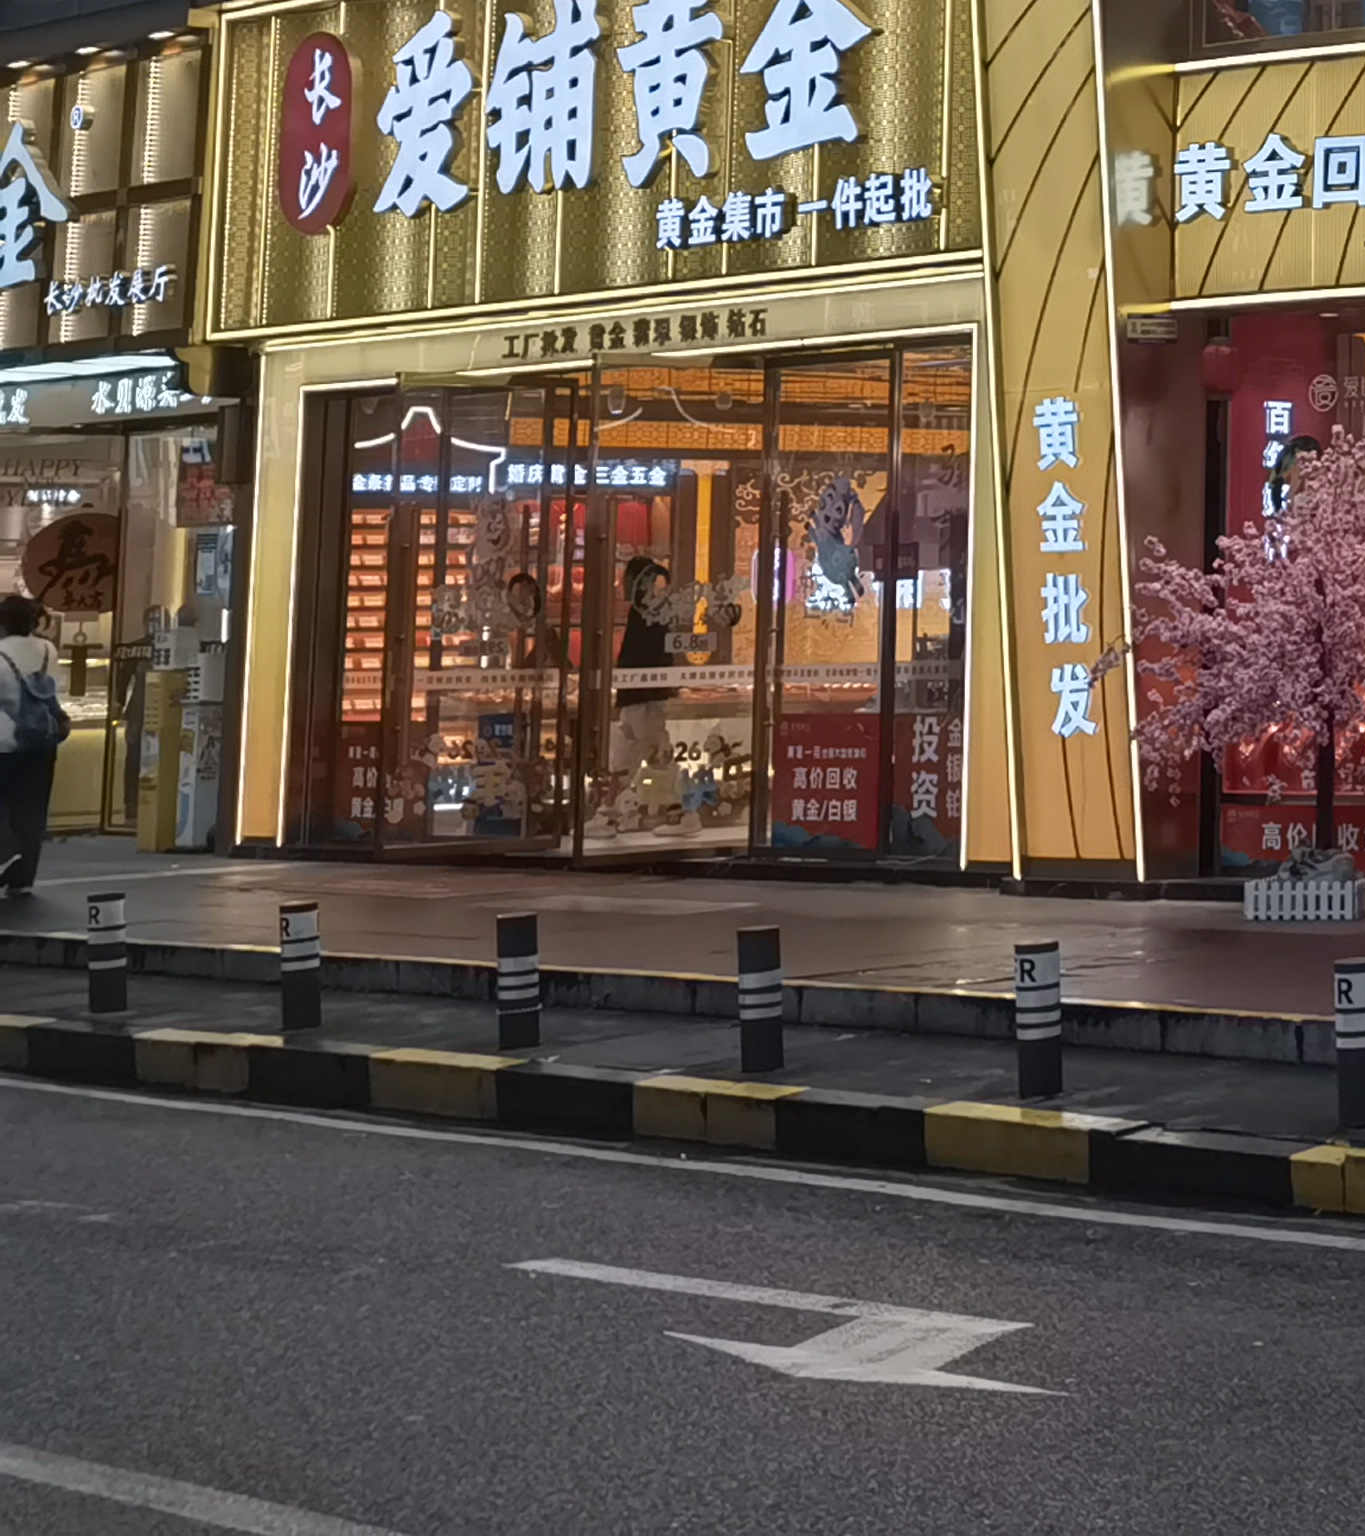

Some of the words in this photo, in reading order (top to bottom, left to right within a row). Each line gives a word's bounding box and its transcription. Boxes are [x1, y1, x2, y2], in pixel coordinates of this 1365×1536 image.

[298, 48, 342, 220] 长沙
[654, 192, 786, 248] 黄金集市
[797, 167, 932, 231] 一件起批
[45, 266, 170, 316] 长沙批发展厅
[502, 327, 577, 360] 工厂批发
[1032, 397, 1098, 738] 黄金批发
[792, 767, 858, 790] 高价回收
[911, 716, 941, 818] 投资
[791, 799, 858, 822] 黄金/白银
[87, 904, 100, 926] R
[280, 916, 290, 938] R
[1018, 957, 1036, 983] R
[1337, 978, 1353, 1006] R
